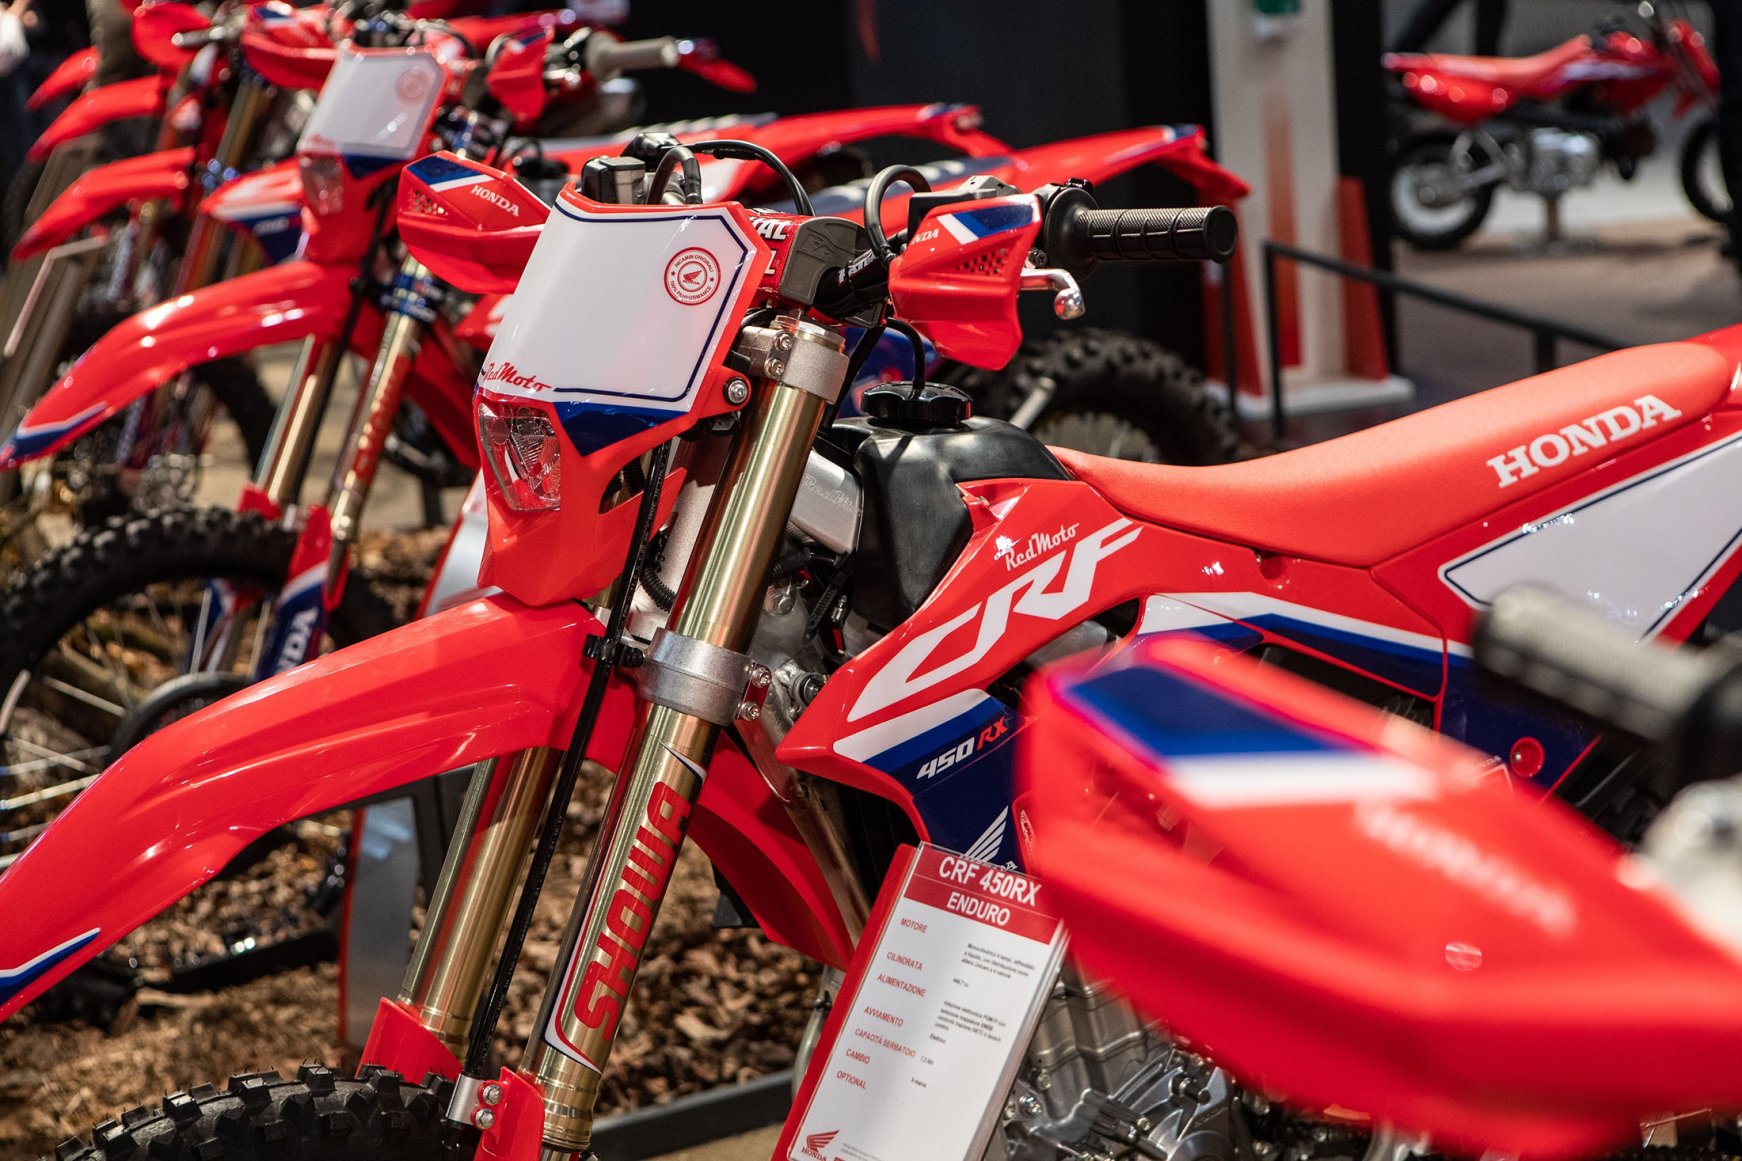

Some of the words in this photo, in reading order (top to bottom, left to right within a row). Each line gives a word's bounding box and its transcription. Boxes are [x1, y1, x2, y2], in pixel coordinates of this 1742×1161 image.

[471, 184, 520, 217] HONDA
[910, 228, 939, 245] NDA
[483, 362, 552, 392] RedMoto
[1486, 393, 1682, 488] HONDA
[1005, 523, 1080, 572] RedMoto
[847, 516, 1143, 723] CRF
[275, 606, 320, 674] NDA
[917, 737, 975, 780] 450
[977, 718, 1008, 751] RX
[939, 856, 980, 885] CRF
[979, 868, 1042, 907] 450RX
[574, 781, 692, 1040] SHOWA
[946, 891, 1011, 926] ENDURO
[901, 918, 928, 934] MOTORE
[886, 951, 923, 971] CILINDRATA
[877, 973, 927, 997] ALIMENTAZIONE
[863, 1006, 904, 1027] AVVIAMENTO
[845, 1048, 871, 1065] CAMBIO
[882, 1039, 916, 1058] SERBATOIO
[836, 1070, 867, 1090] OPTIONAL
[801, 1146, 827, 1161] HONDA
